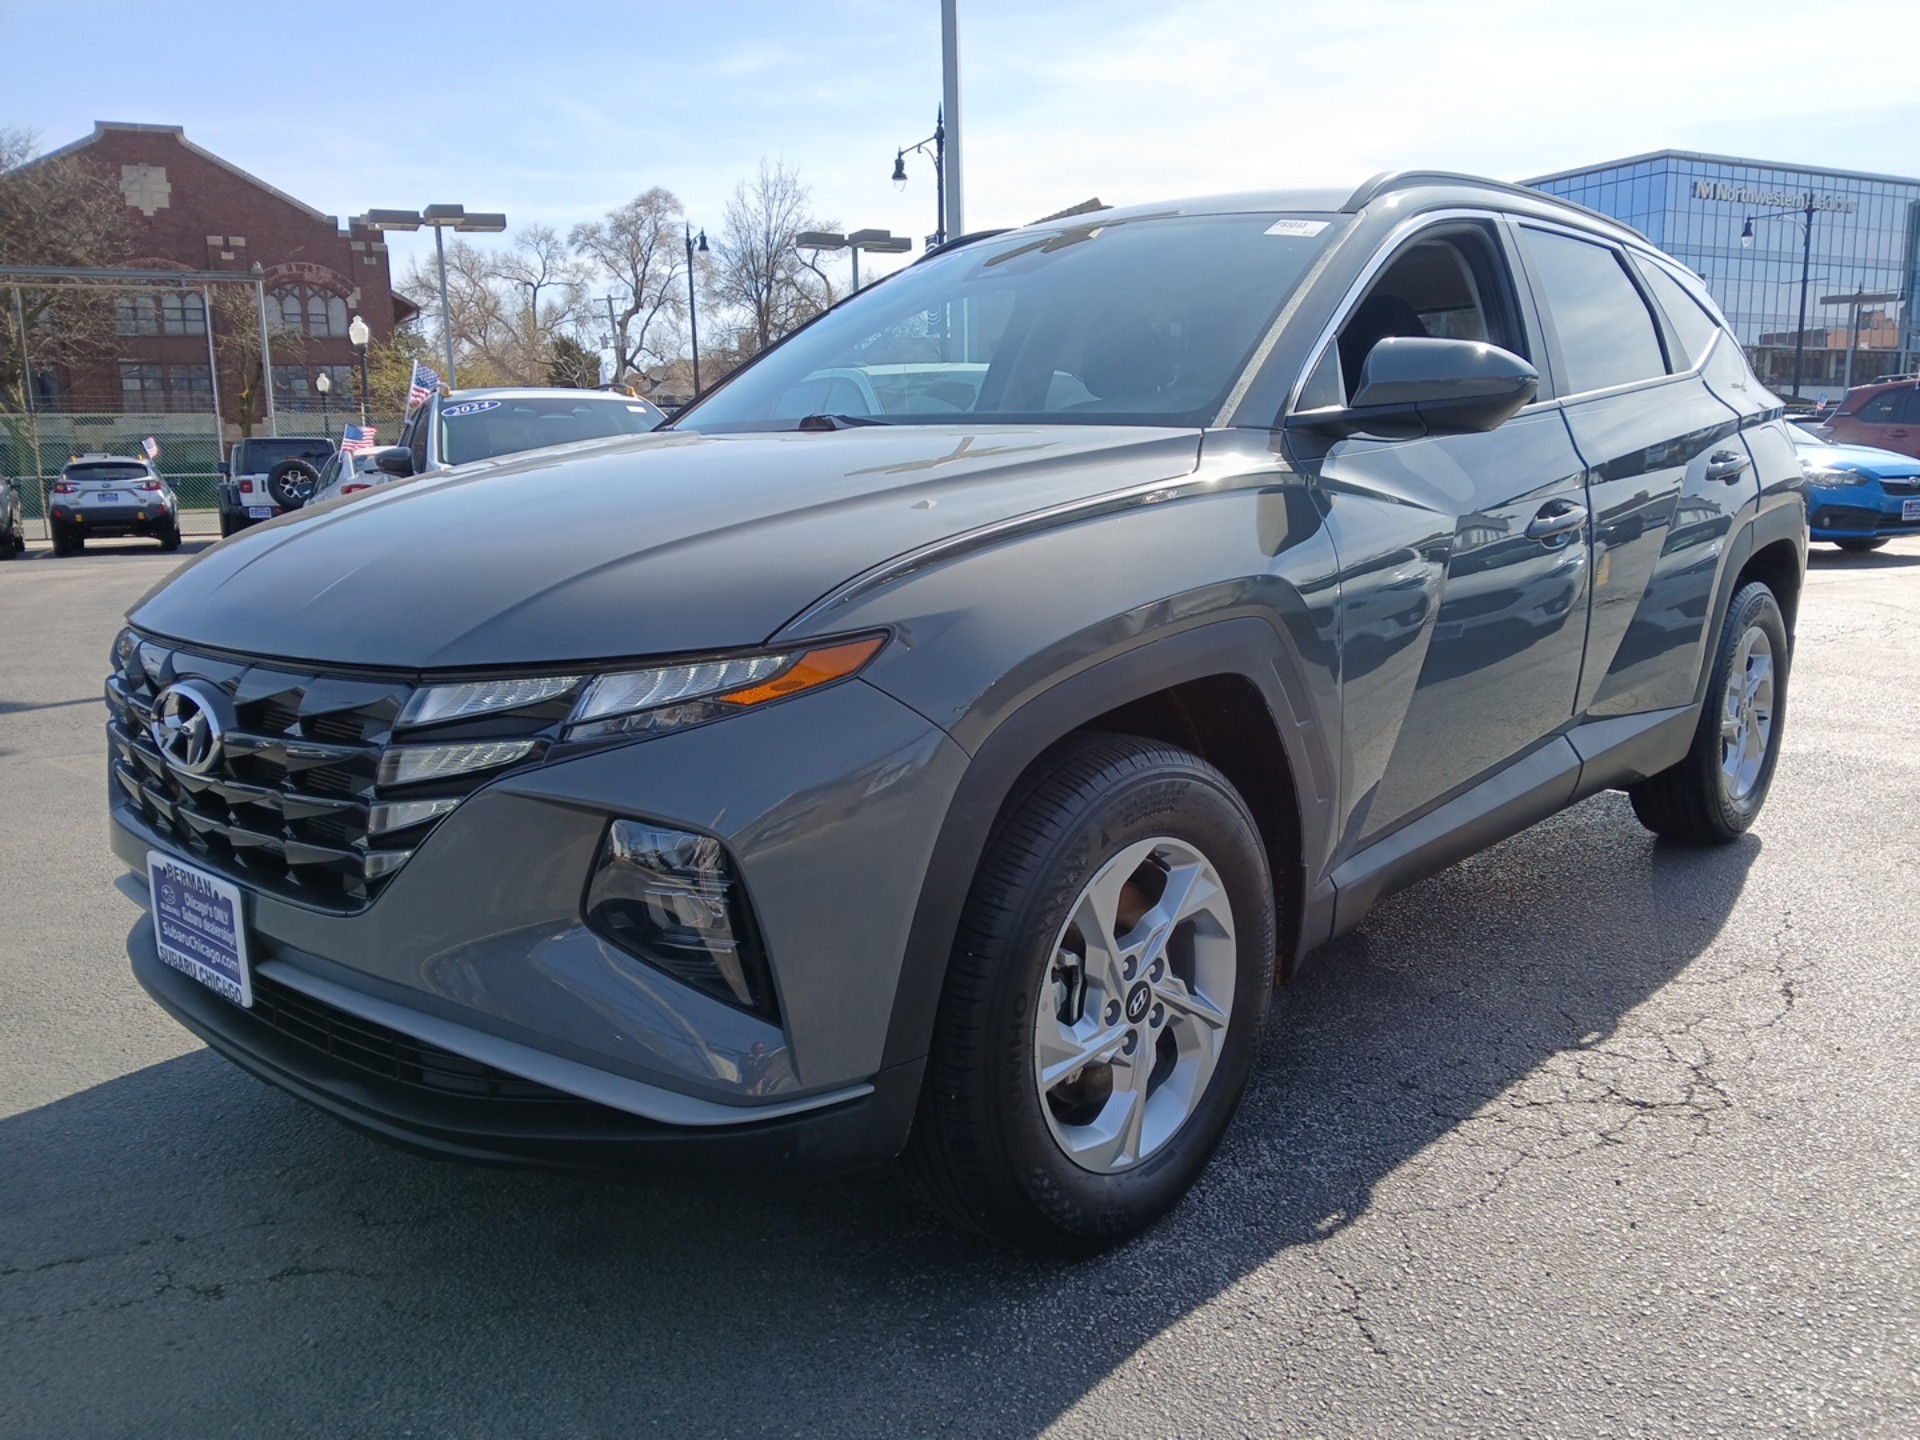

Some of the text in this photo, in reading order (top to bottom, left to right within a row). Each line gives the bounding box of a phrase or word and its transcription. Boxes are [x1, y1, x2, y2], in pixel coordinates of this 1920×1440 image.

[1715, 182, 1807, 209] Northwestern
[166, 862, 213, 898] BERMAN
[181, 906, 203, 928] Subaru
[162, 921, 240, 975] SubaruChicago.com
[159, 945, 243, 1005] SUBARU CHICAGO
